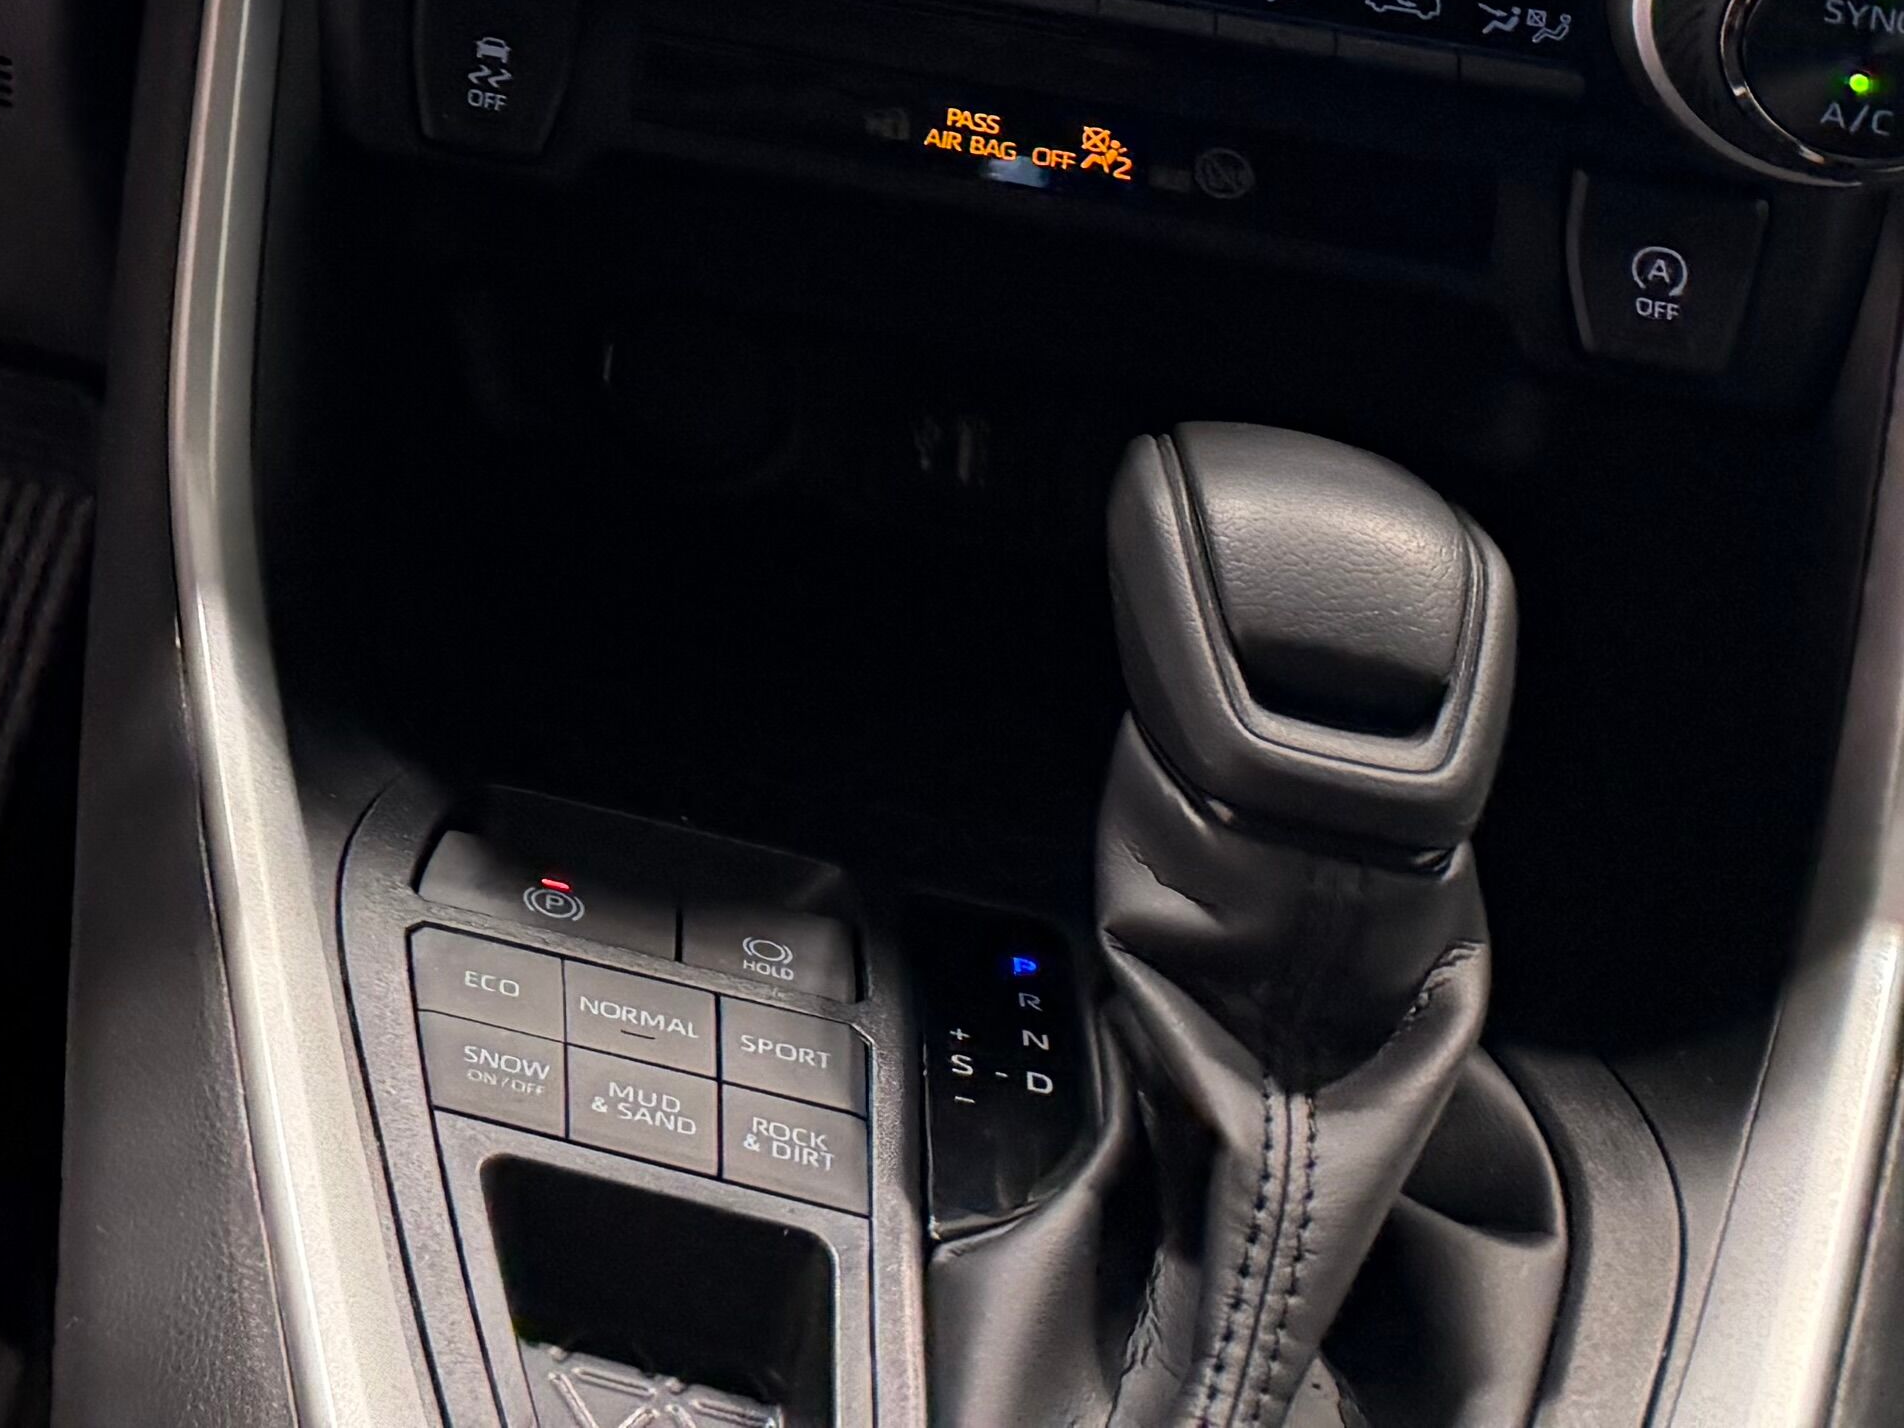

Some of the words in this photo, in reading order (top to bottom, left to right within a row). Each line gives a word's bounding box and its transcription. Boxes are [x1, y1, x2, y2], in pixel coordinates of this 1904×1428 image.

[466, 88, 508, 112] OFF
[946, 107, 1001, 135] PASS
[1821, 101, 1894, 136] A/C
[923, 128, 963, 153] AIR
[969, 135, 1018, 161] BAG
[1031, 147, 1077, 171] OFF
[1113, 156, 1133, 181] 2
[1635, 297, 1681, 322] OFF
[742, 958, 795, 982] HOLD
[1013, 956, 1038, 976] P
[464, 970, 521, 998] ECO
[1018, 991, 1043, 1012] R
[580, 995, 700, 1040] NORMAL
[740, 1035, 832, 1070] SPORT
[1022, 1029, 1051, 1051] N
[463, 1045, 552, 1082] SNOW
[950, 1053, 974, 1076] S
[1026, 1070, 1054, 1095] D
[608, 1081, 682, 1114] MUD
[591, 1095, 609, 1114] &
[617, 1102, 697, 1136] SAND
[751, 1116, 830, 1152] ROCK
[742, 1133, 762, 1153] &
[771, 1142, 835, 1172] DIRT
